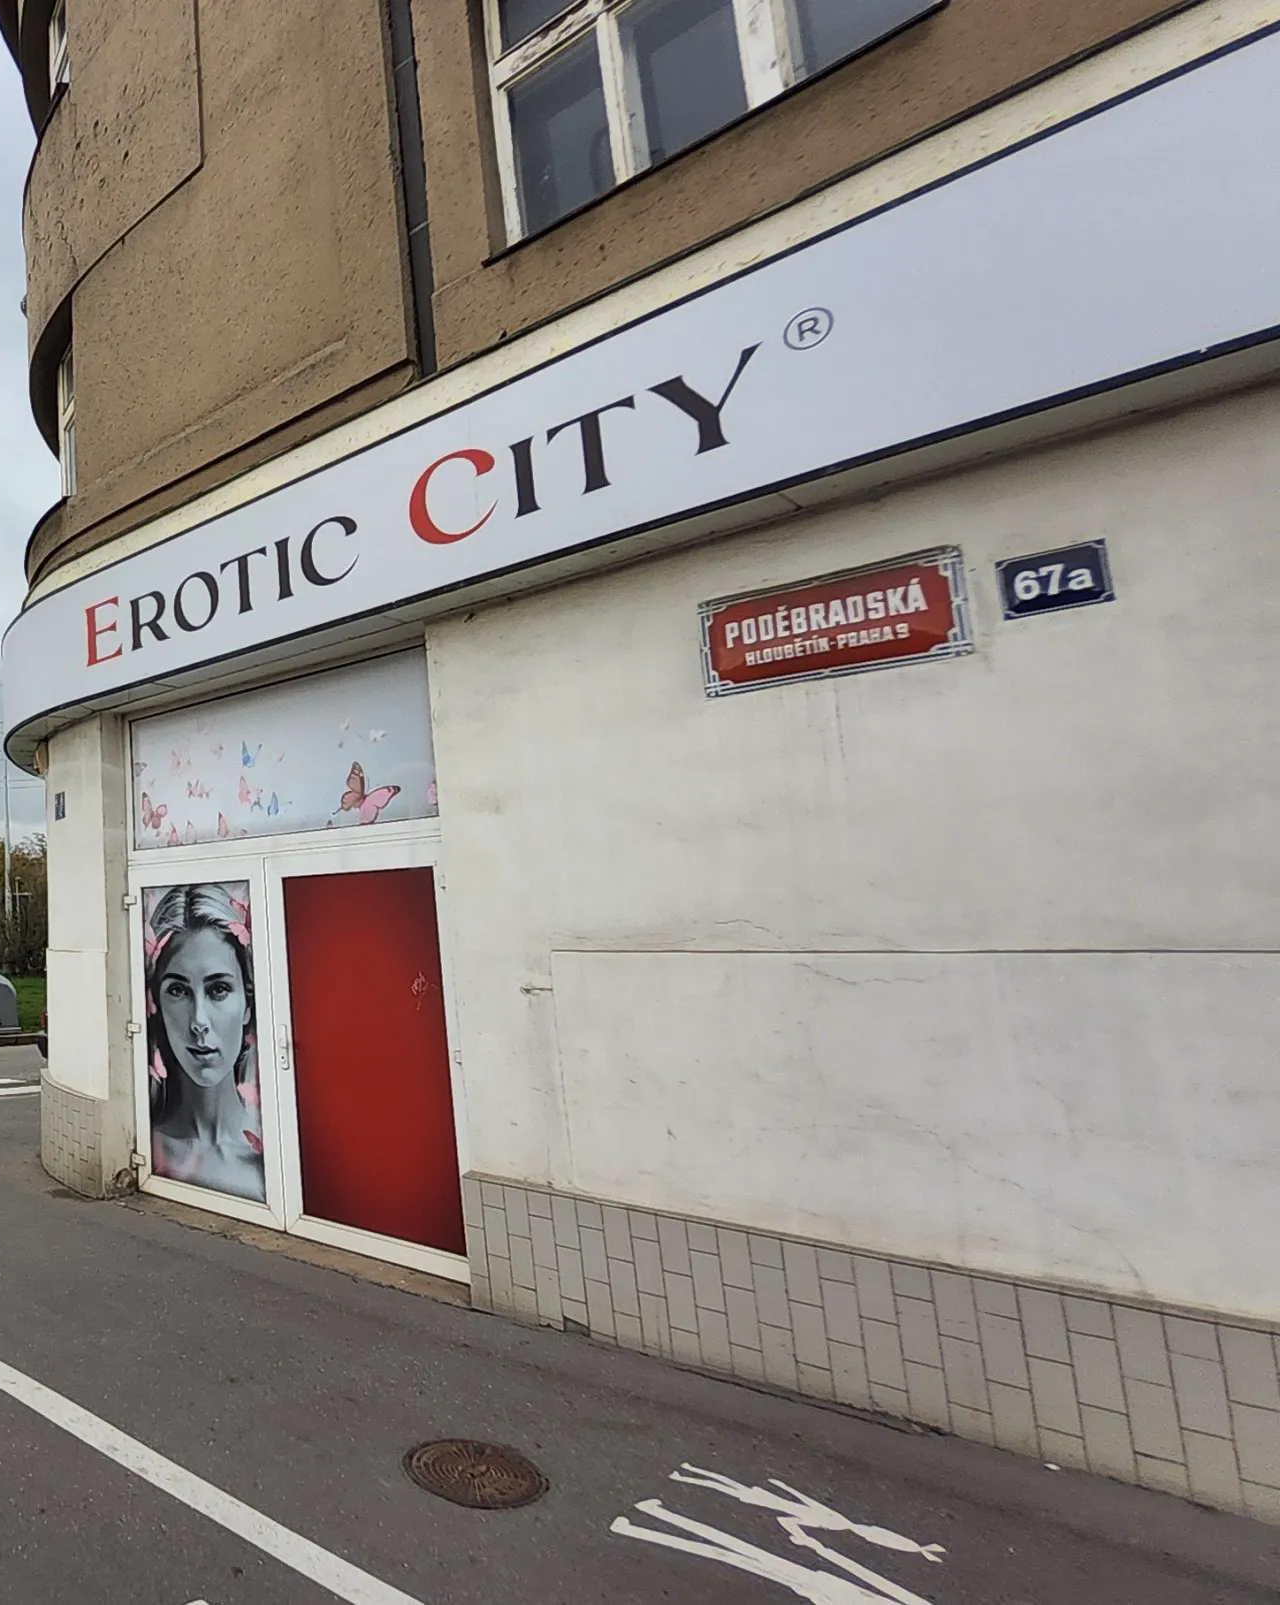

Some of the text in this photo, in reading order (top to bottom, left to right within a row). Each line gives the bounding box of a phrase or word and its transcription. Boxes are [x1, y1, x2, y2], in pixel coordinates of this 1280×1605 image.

[86, 516, 359, 667] EROTIC
[409, 342, 763, 545] CITY
[725, 578, 929, 649] PODĚBRADSKÁ
[1014, 563, 1095, 600] 67a
